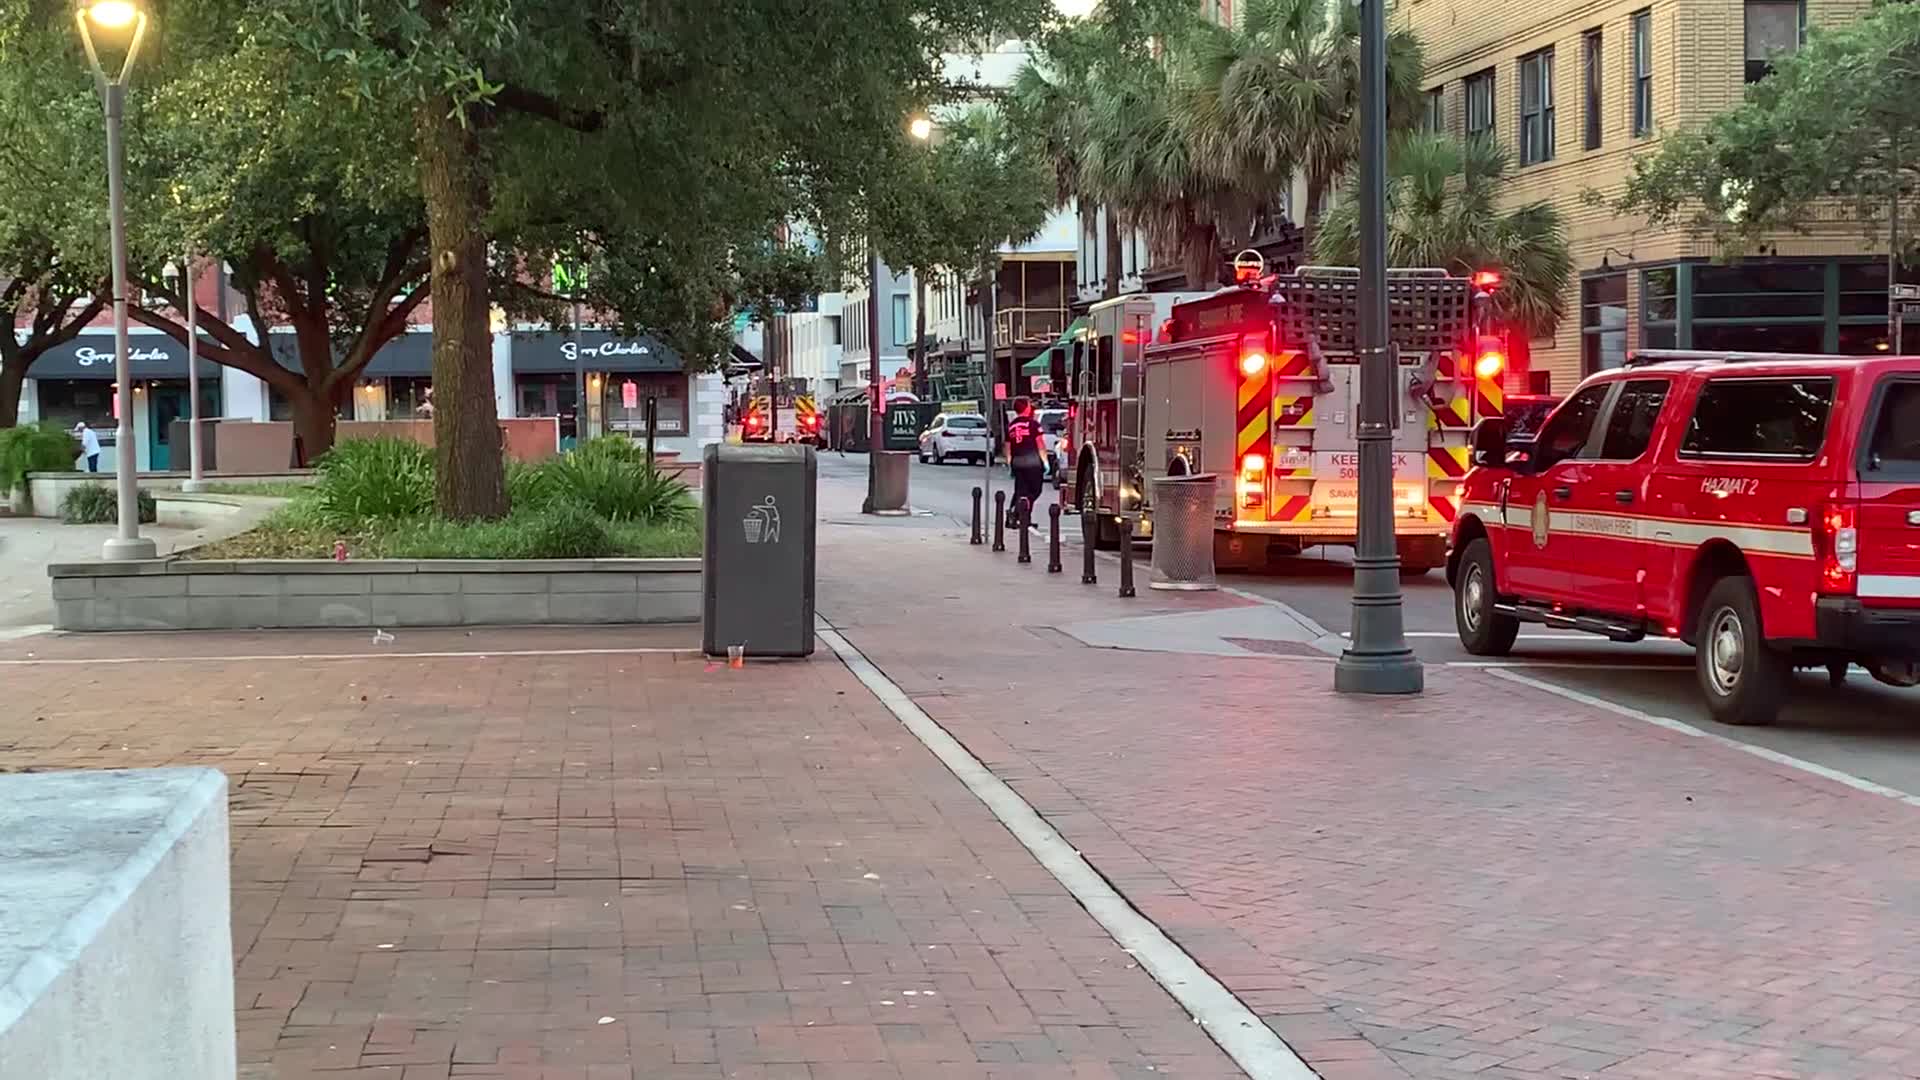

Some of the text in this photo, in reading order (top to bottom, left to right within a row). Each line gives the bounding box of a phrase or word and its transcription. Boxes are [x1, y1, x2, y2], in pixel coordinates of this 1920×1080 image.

[560, 342, 599, 360] Srry
[892, 410, 916, 425] JTVS
[1331, 454, 1358, 465] KEE
[1700, 477, 1760, 496] HAZMAT 2
